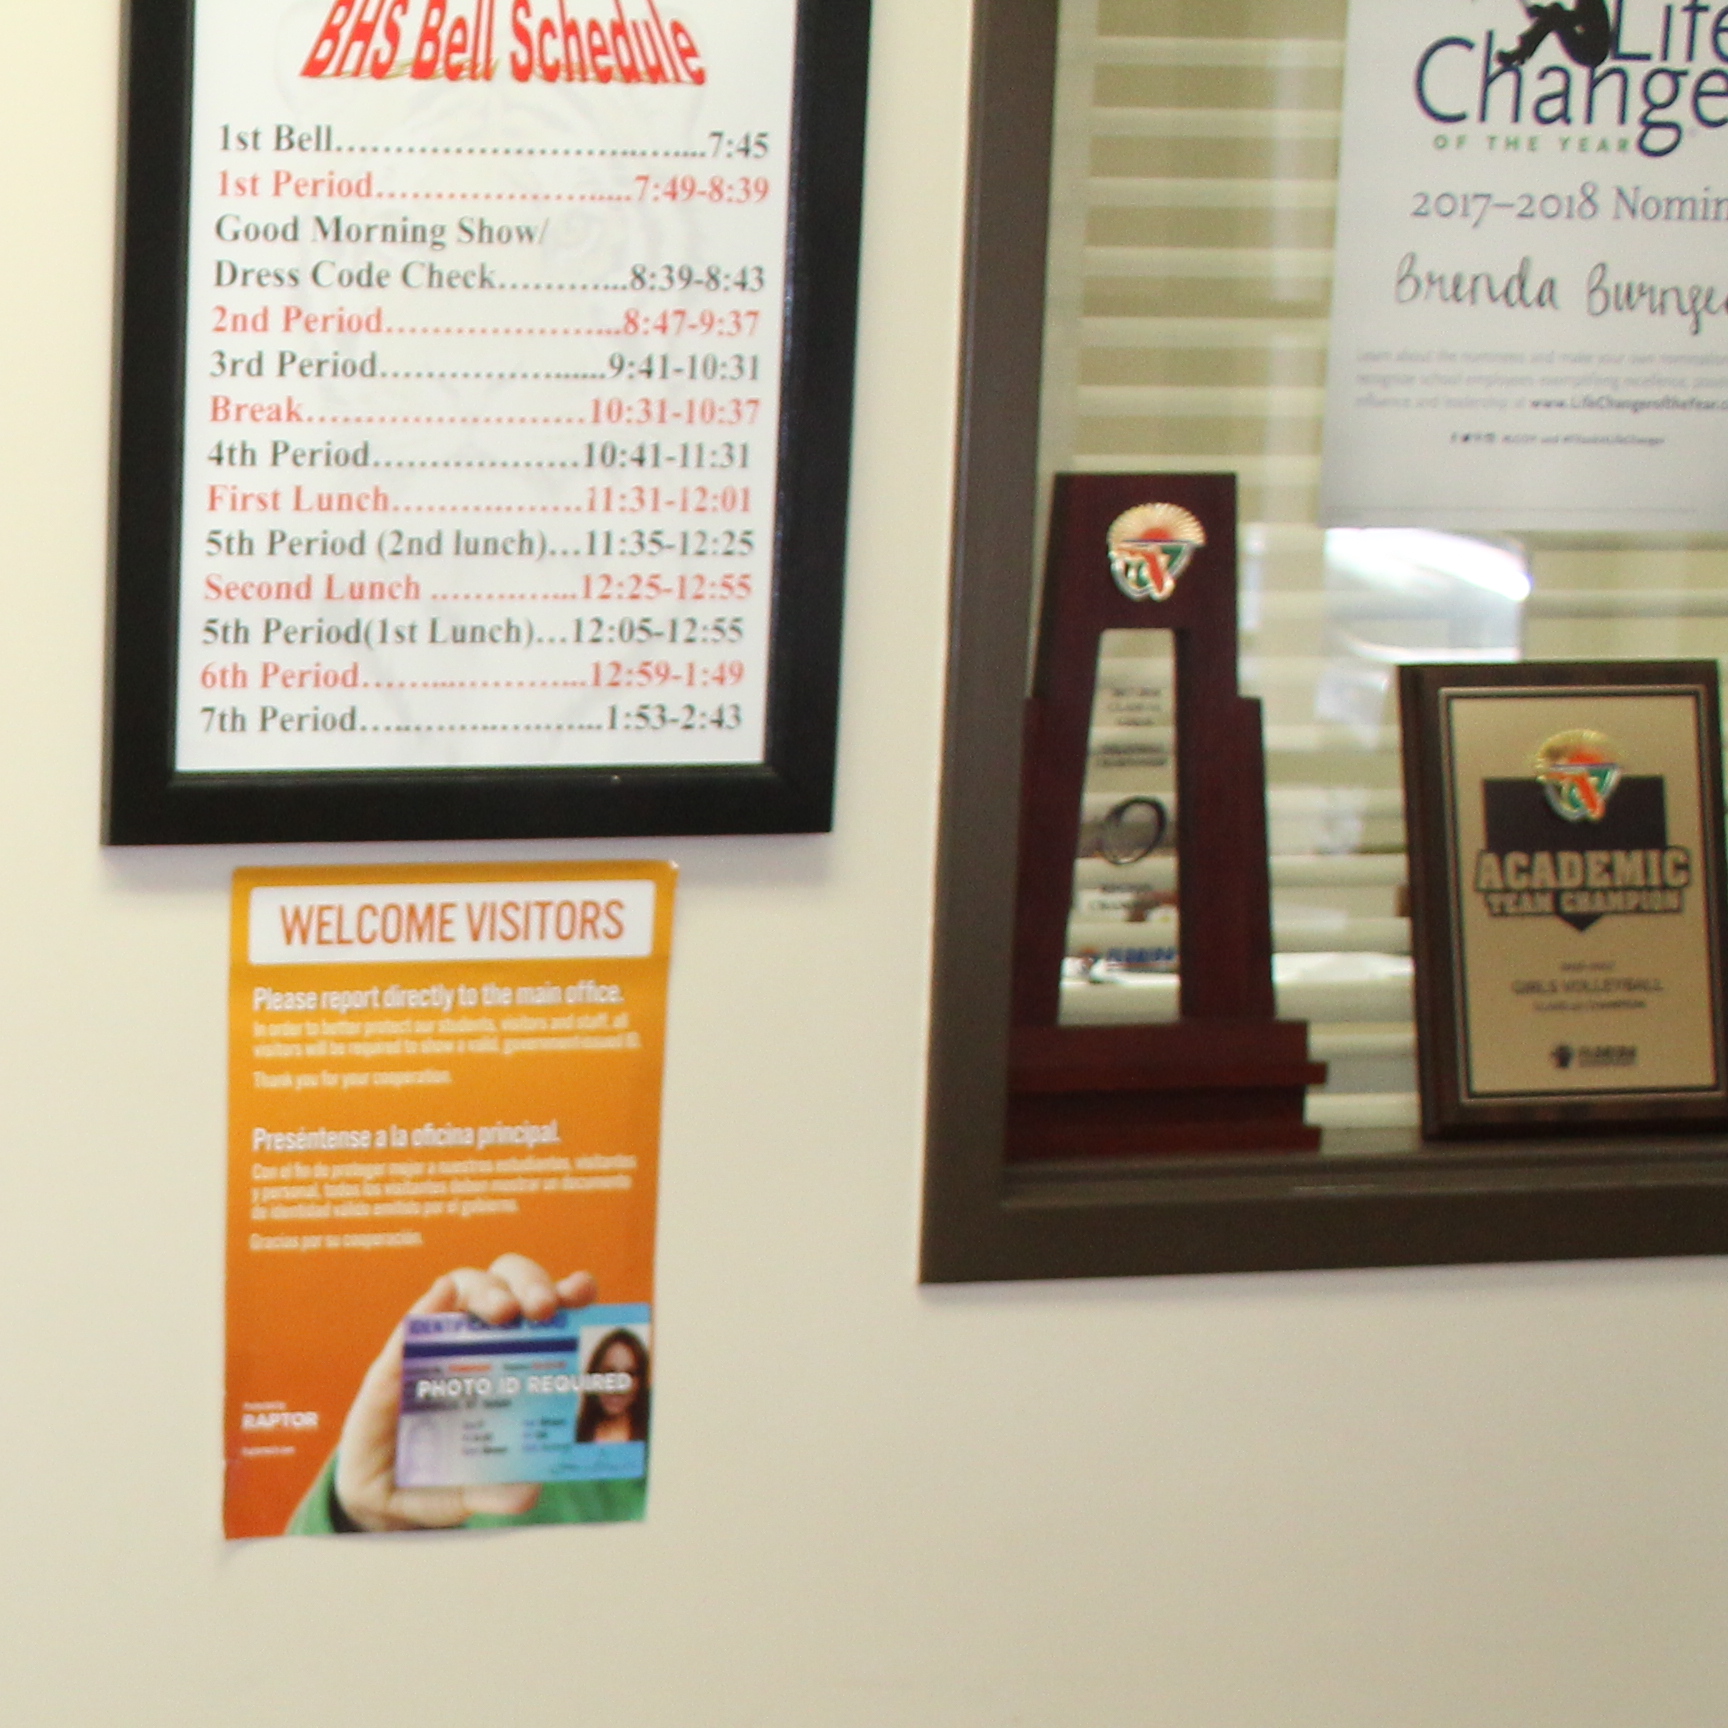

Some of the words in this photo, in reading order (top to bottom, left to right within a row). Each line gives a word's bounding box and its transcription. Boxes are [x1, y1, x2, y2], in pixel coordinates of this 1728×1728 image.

[300, 0, 409, 78] BHS
[411, 0, 497, 81] Bell
[509, 0, 707, 85] Schedule
[218, 124, 262, 152] 1st
[271, 124, 333, 153] Bell
[708, 131, 769, 159] 7:45
[1432, 134, 1468, 152] OF
[1486, 134, 1540, 152] THE
[1558, 134, 1631, 153] YEAR
[218, 170, 262, 199] 1st
[270, 170, 373, 200] Period
[633, 174, 770, 204] 7:49-8:39
[214, 215, 299, 245] Good
[311, 216, 446, 251] Morning
[456, 216, 551, 247] Show/
[213, 260, 300, 290] Dress
[310, 260, 392, 290] Code
[400, 260, 496, 290] Check
[629, 264, 766, 293] 8:39-8:43
[1394, 251, 1561, 312] Brenda
[1585, 262, 1728, 336] Burnge
[211, 305, 270, 335] 2nd
[281, 305, 384, 336] Period
[623, 308, 760, 338] 8:47-9:37
[210, 350, 265, 379] 3rd
[277, 350, 377, 380] Period
[608, 353, 761, 382] 9:41-10:31
[210, 396, 304, 424] Break
[589, 397, 761, 426] 10:31-10:37
[207, 441, 257, 469] 4th
[270, 441, 370, 470] Period
[583, 441, 750, 470] 10:41-11:31
[207, 484, 282, 513] First
[291, 484, 391, 513] Lunch
[586, 486, 753, 514] 11:31-12:01
[205, 529, 255, 558] 5th
[267, 529, 367, 559] Period
[376, 529, 443, 562] (2nd
[453, 529, 548, 563] lunch)
[586, 530, 755, 558] 11:35-12:25
[203, 573, 313, 602] Second
[324, 573, 422, 602] Lunch
[580, 573, 753, 601] 12:25-12:55
[201, 617, 253, 646] 5th
[427, 617, 537, 649] Lunch)
[572, 617, 746, 645] 12:05-12:55
[200, 661, 249, 690] 6th
[260, 661, 360, 690] Period
[590, 661, 745, 689] 12:59-1:49
[200, 705, 249, 734] 7th
[258, 705, 358, 733] Period
[606, 704, 744, 732] 1:53-2:43
[1475, 846, 1691, 892] ACADEMIC
[281, 902, 456, 946] WELCOME
[467, 899, 625, 942] VISITORS
[253, 987, 318, 1012] Please
[320, 985, 381, 1014] report
[383, 983, 456, 1014] directly
[457, 983, 480, 1008] to
[480, 982, 514, 1008] the
[515, 981, 564, 1006] main
[564, 979, 626, 1007] office.
[374, 1128, 388, 1150] a
[389, 1124, 410, 1149] la
[411, 1121, 475, 1149] oficina
[416, 1377, 493, 1398] PHOTO
[498, 1377, 521, 1396] ID
[526, 1372, 633, 1396] REQUIRED
[241, 1410, 319, 1433] RAPTOR
